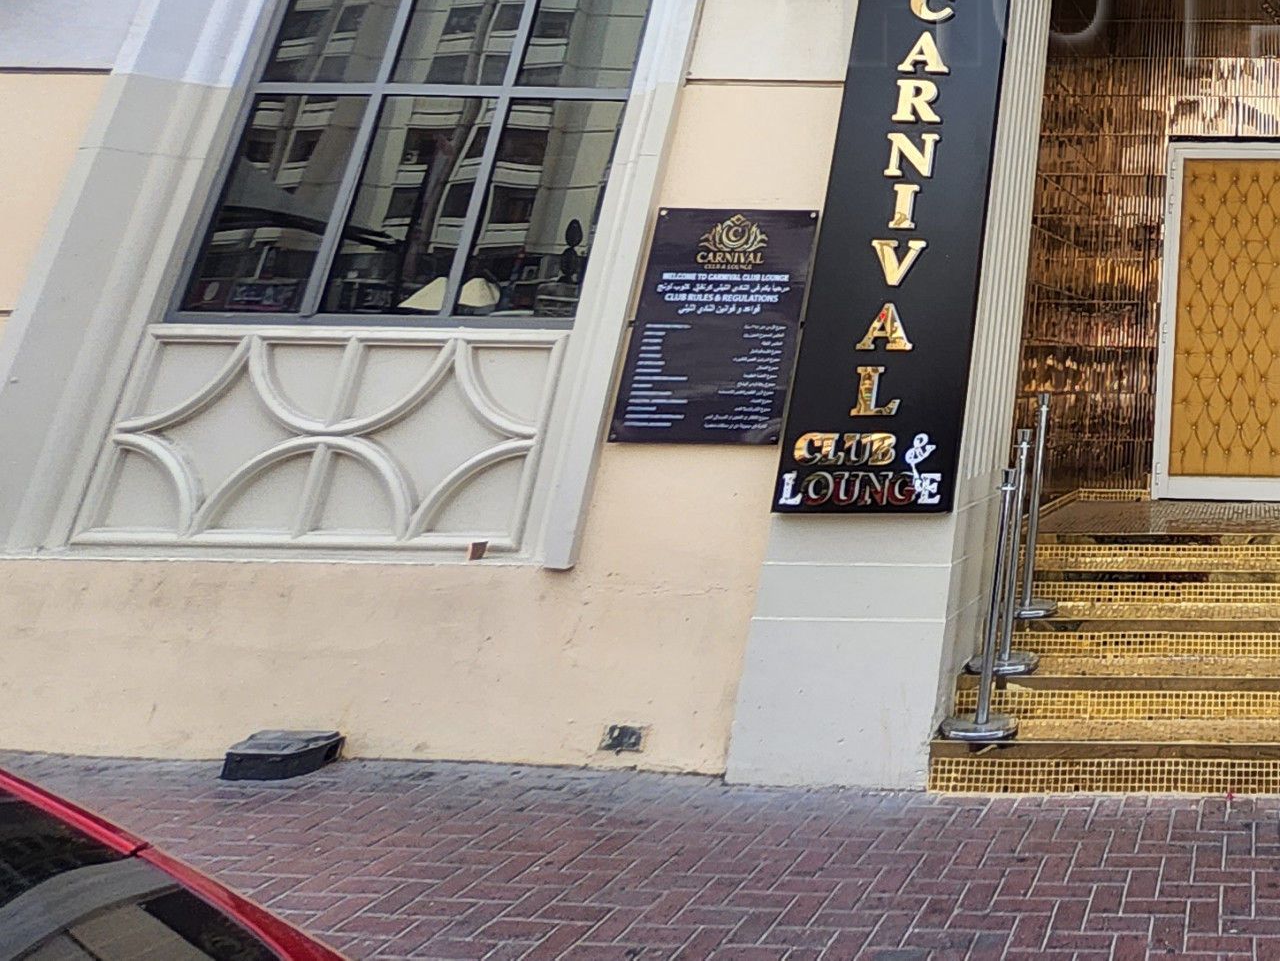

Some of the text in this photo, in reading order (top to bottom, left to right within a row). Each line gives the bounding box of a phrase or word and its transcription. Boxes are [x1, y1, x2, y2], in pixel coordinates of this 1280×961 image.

[696, 252, 765, 264] CARNIVAL
[662, 272, 790, 282] WELCOME TO CARNIVAL CLUB LOUNGE
[664, 293, 687, 302] CLUB
[687, 293, 714, 302] RULES
[721, 294, 779, 303] REGULATIONS
[793, 432, 937, 466] CLUB &
[778, 470, 943, 506] LOUNGE
